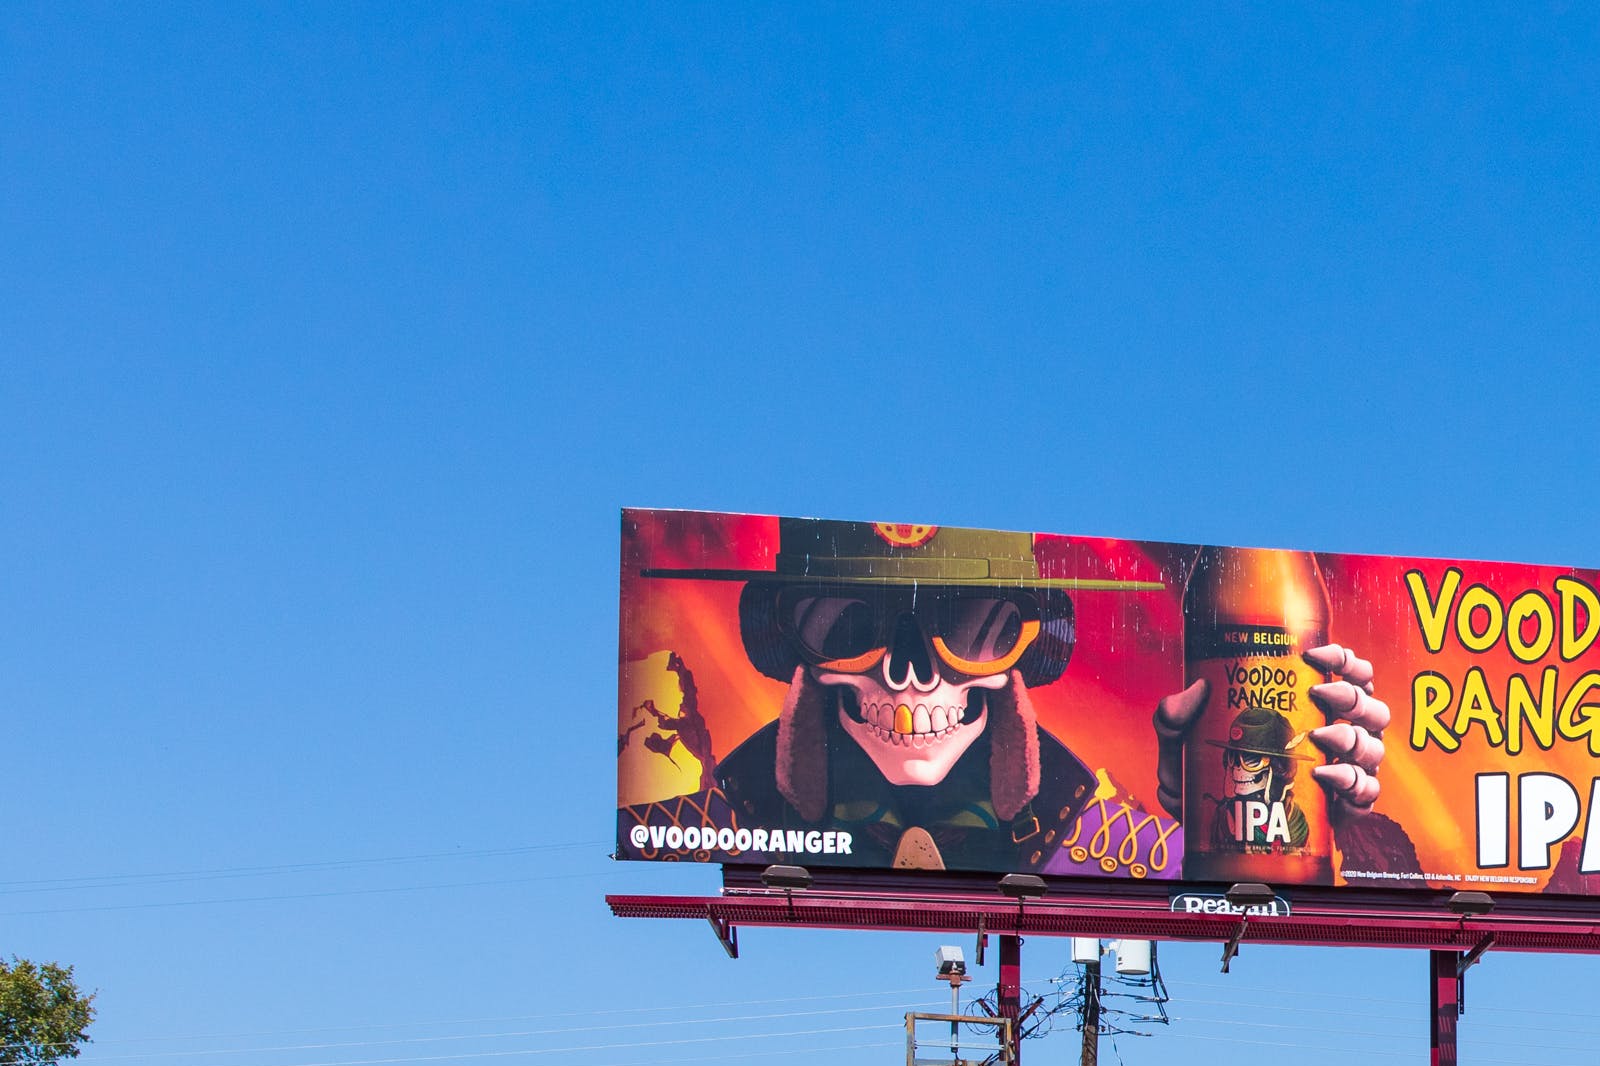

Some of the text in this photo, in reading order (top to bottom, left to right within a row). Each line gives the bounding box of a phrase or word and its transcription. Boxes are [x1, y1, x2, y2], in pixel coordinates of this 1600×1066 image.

[1225, 632, 1298, 646] NEW BELGIUM
[1225, 661, 1297, 688] VOODOO
[1227, 686, 1298, 712] RANGER
[1234, 800, 1291, 843] IPA
[630, 825, 853, 855] @VOODOORANGER
